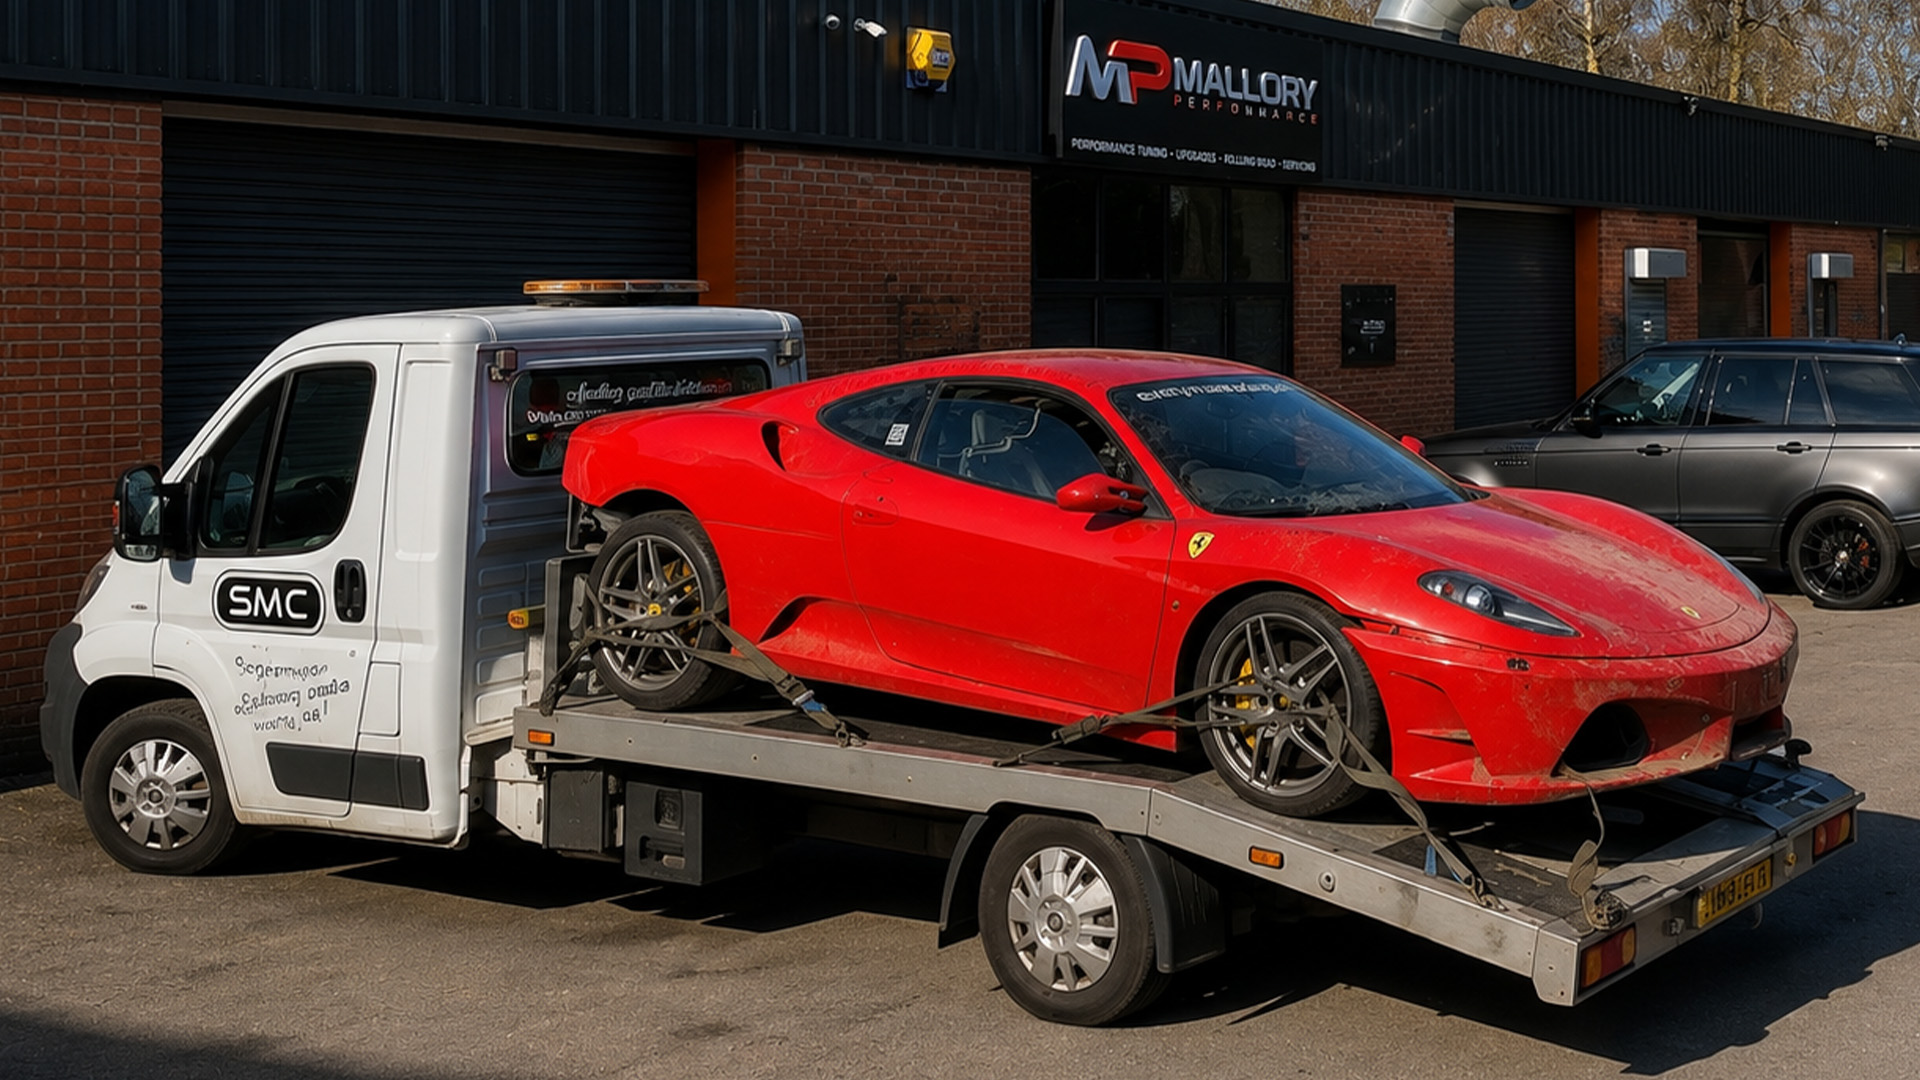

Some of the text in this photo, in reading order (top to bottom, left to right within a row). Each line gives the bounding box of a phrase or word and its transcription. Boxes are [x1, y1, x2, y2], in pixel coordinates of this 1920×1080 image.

[1065, 34, 1171, 104] MP
[1173, 56, 1318, 110] MALLORY
[228, 584, 308, 620] SMC
